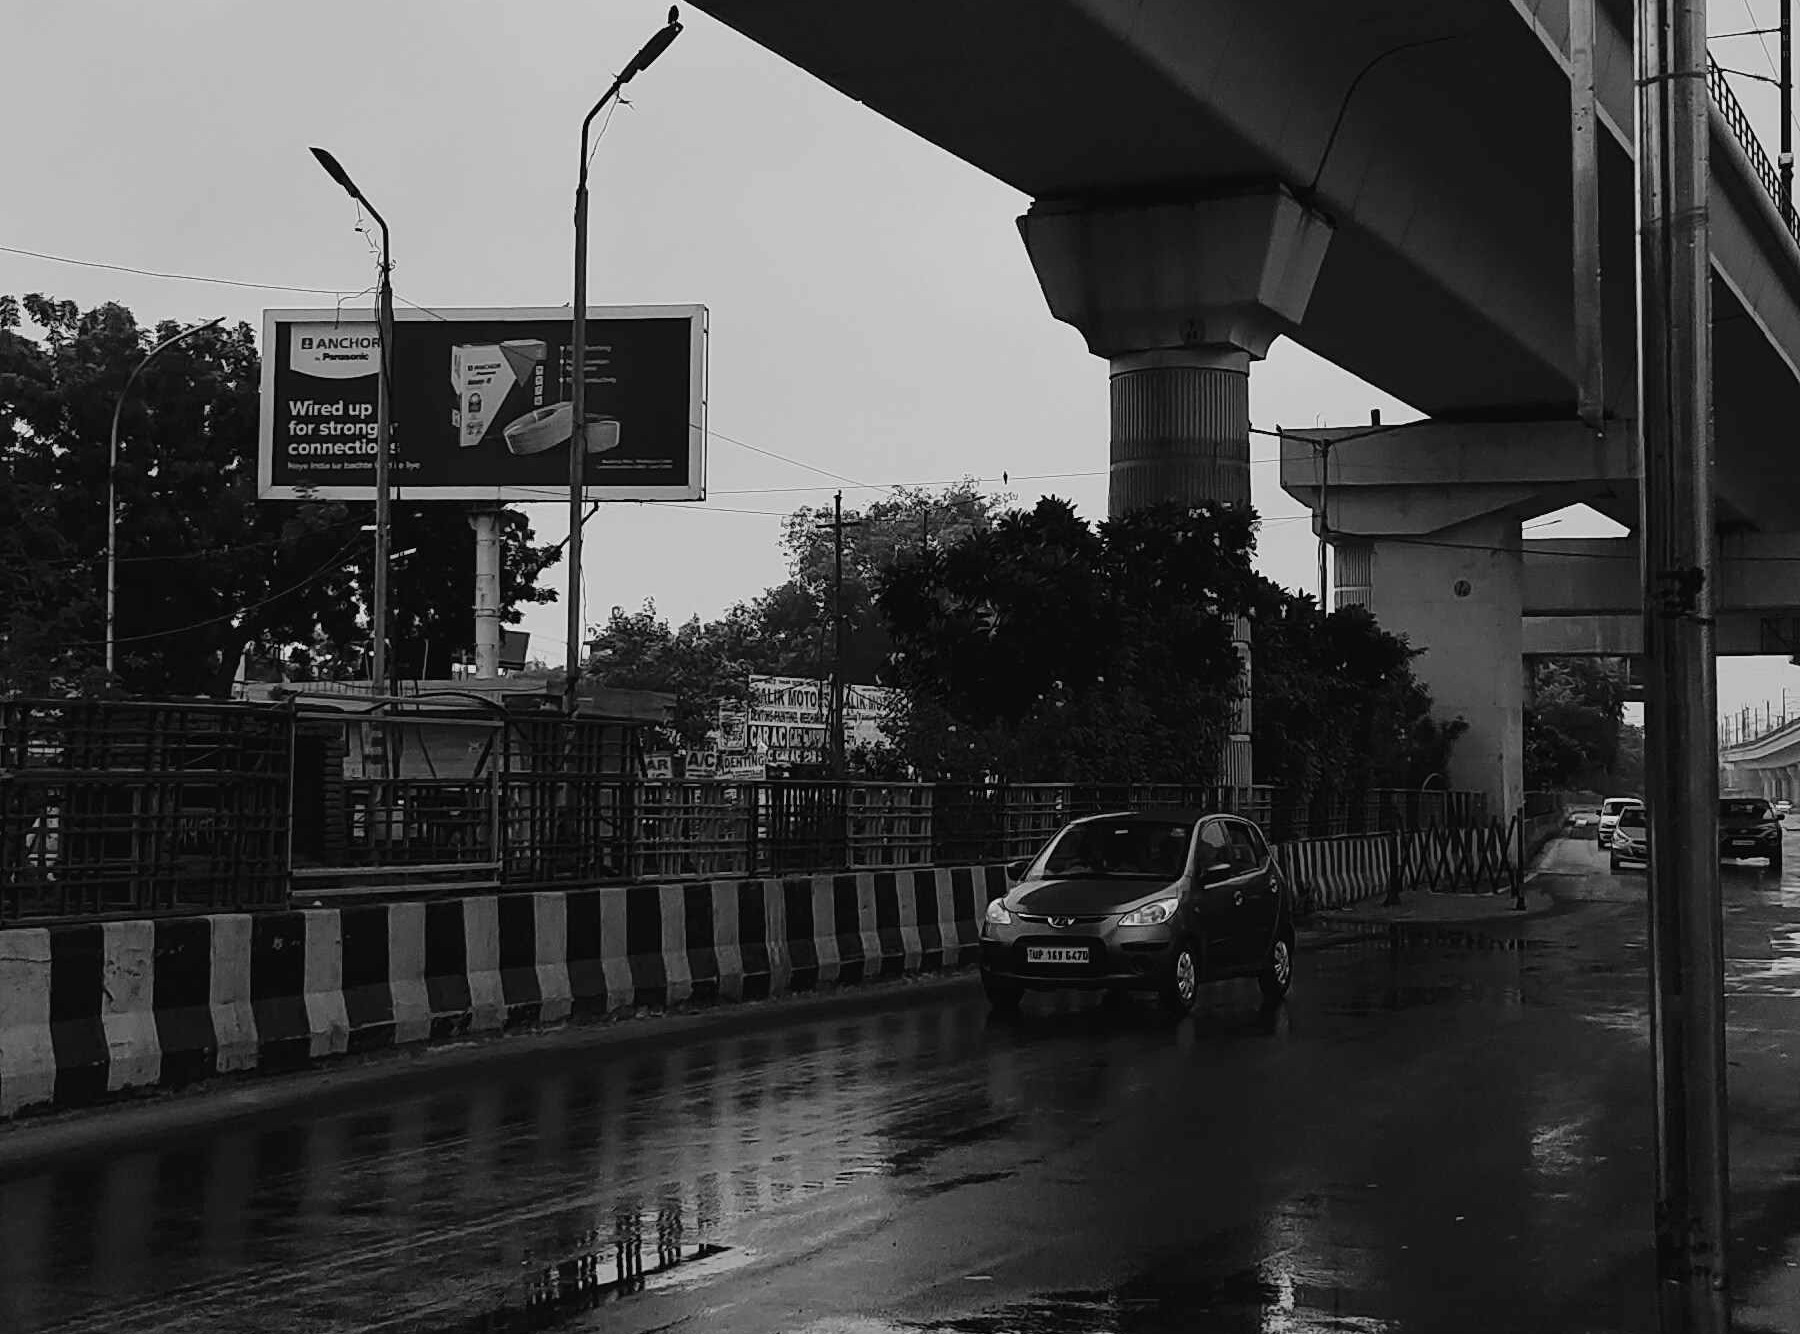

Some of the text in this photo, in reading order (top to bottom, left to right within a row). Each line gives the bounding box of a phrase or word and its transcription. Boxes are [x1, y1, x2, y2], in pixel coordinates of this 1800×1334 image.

[316, 338, 380, 349] ANCHOR
[322, 353, 369, 361] Panasonic
[289, 399, 373, 420] Wired up
[288, 420, 399, 439] for strongr
[287, 439, 401, 455] connectios
[750, 725, 769, 748] CAR
[724, 756, 764, 769] DENTING
